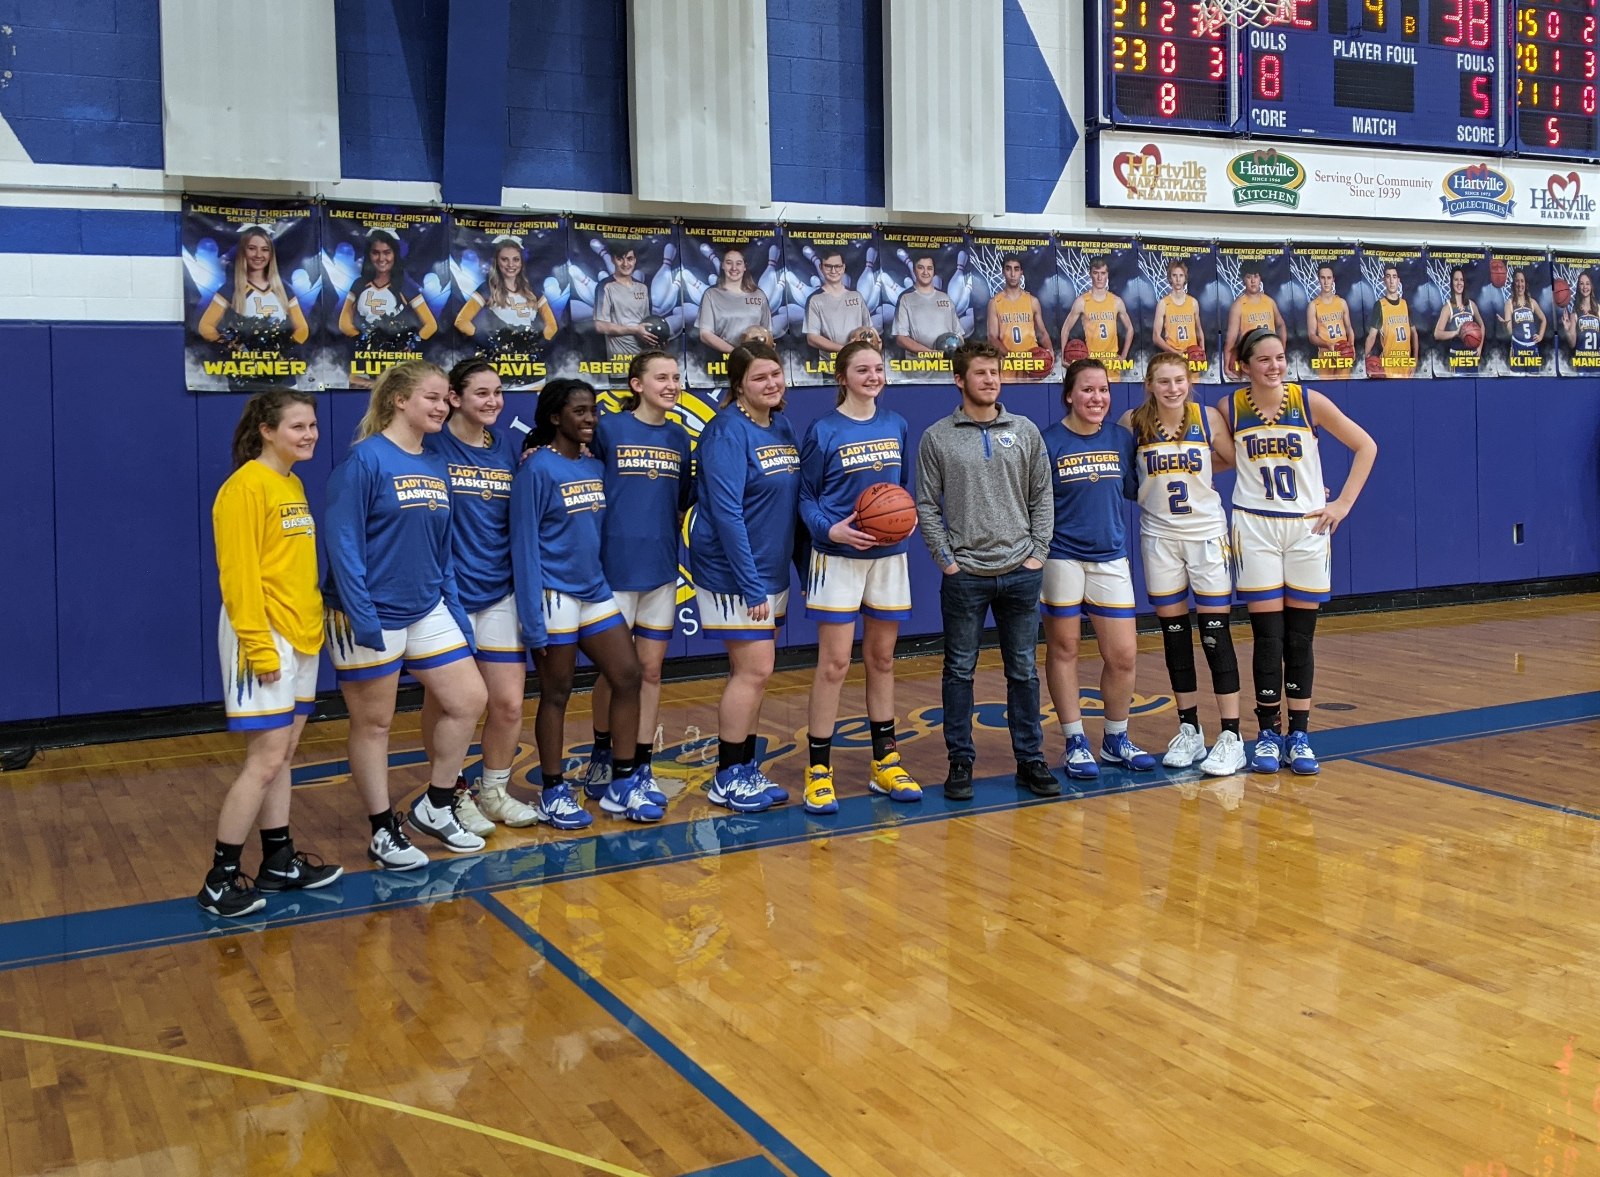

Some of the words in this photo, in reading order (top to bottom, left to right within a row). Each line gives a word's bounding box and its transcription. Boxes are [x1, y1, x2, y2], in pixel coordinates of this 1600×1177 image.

[1161, 1, 1175, 32] 2
[1443, 0, 1489, 46] 38
[1517, 8, 1538, 36] 15
[1548, 11, 1560, 38] 0
[1584, 16, 1595, 42] 2
[1250, 30, 1287, 51] OULS
[1114, 37, 1147, 71] 23
[1161, 41, 1176, 73] 0
[1210, 46, 1223, 78] 3
[1333, 40, 1383, 61] PLAYER
[1386, 45, 1418, 65] FOUL
[1457, 53, 1495, 73] FOULS
[1585, 51, 1595, 77] 3
[1260, 55, 1280, 97] 8
[1161, 82, 1176, 115] 8
[1472, 76, 1490, 115] 5
[1584, 86, 1595, 112] 0
[1251, 108, 1287, 128] CORE
[1352, 116, 1396, 135] MATCH
[1457, 125, 1495, 143] SCORE
[1548, 117, 1560, 145] 5
[1126, 153, 1207, 179] Hartville
[1239, 160, 1294, 177] Hartville
[1126, 176, 1207, 190] MARKETPLACE
[1315, 169, 1351, 186] Serving
[1354, 172, 1374, 185] Our
[1376, 174, 1433, 190] Community
[1453, 175, 1504, 191] Hartville
[1164, 191, 1207, 202] MARKET
[1237, 188, 1295, 203] KITCHEN
[1349, 185, 1375, 198] Since
[1378, 187, 1401, 199] 1939
[1530, 188, 1596, 212] Hartville
[191, 204, 217, 214] LAKE
[219, 207, 256, 217] CENTER
[259, 209, 310, 218] CHRISTIAN
[1450, 199, 1505, 215] COLLECTIBLES
[1541, 210, 1590, 220] HARDWARE
[330, 210, 354, 219] LAKE
[355, 212, 393, 221] CENTER
[394, 214, 441, 223] CHRISTIAN
[455, 218, 477, 227] LAKE
[574, 222, 596, 231] LAKE
[597, 224, 628, 234] CENTER
[629, 226, 672, 235] CHRISTIAN
[685, 228, 706, 236] LAKE
[707, 229, 737, 237] CENTER
[788, 231, 807, 239] LAKE
[836, 232, 872, 240] CHRISTIAN
[884, 234, 902, 242] LAKE
[902, 235, 929, 243] CENTER
[930, 236, 964, 244] CHRISTIAN
[991, 238, 1016, 246] CENTER
[1016, 239, 1049, 247] CHRISTIAN
[1012, 326, 1022, 344] 0
[1099, 323, 1108, 339] 3
[1327, 324, 1343, 340] 24
[1395, 326, 1407, 342] 10
[1522, 323, 1531, 339] 5
[1585, 332, 1598, 350] 21
[231, 351, 280, 360] HAILEY
[354, 351, 424, 360] KATHERINE
[499, 353, 529, 361] ALEX
[1311, 358, 1354, 369] BYLER
[1381, 357, 1417, 368] ICKES
[1449, 357, 1481, 367] WEST
[1510, 357, 1542, 367] KLINE
[203, 361, 307, 376] WAGNER
[350, 360, 400, 376] LUT
[1000, 359, 1046, 371] ABER
[756, 448, 779, 460] LADY
[840, 445, 866, 457] LADY
[867, 442, 899, 451] TIGERS
[1242, 433, 1303, 461] TIGERS
[617, 449, 647, 458] LADY
[648, 450, 682, 462] TIGERS
[842, 451, 901, 467] BASKETBALL
[1057, 456, 1084, 468] LADY
[1085, 454, 1119, 463] TIGERS
[1143, 448, 1202, 477] TIGERS
[449, 467, 478, 478] LADY
[1058, 463, 1121, 476] BASKETBALL
[394, 479, 421, 490] LADY
[1259, 465, 1298, 500] 10
[561, 485, 585, 497] LADY
[1167, 481, 1192, 515] 2
